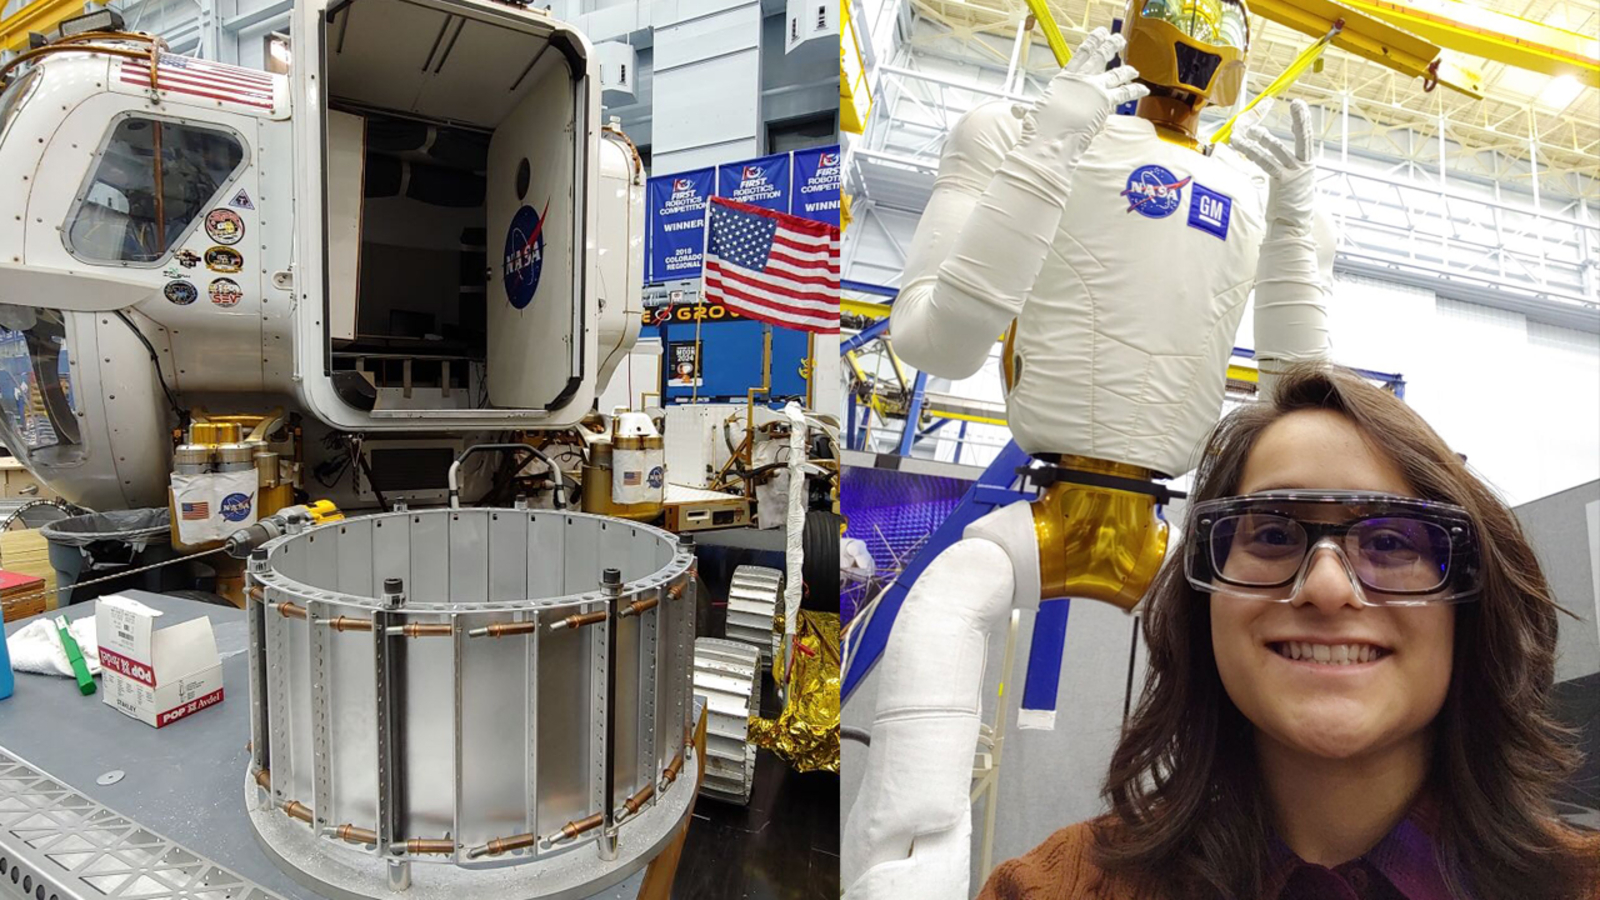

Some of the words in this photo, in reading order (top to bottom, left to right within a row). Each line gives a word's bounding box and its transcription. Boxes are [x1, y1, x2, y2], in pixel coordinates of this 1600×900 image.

[740, 177, 767, 189] FIRST
[671, 190, 696, 201] FIRST
[733, 184, 774, 197] ROBOTICS
[1131, 181, 1179, 201] NASA
[665, 196, 702, 208] ROBOTICS
[1200, 195, 1223, 220] GM
[664, 219, 704, 232] WINNER
[675, 247, 692, 256] 2018
[505, 241, 541, 275] NASA
[665, 253, 702, 264] COLORADO
[666, 261, 701, 271] REGIONAL
[223, 502, 249, 512] NASA
[131, 664, 151, 682] POP
[163, 708, 186, 723] POP
[198, 692, 220, 708] Avdel
